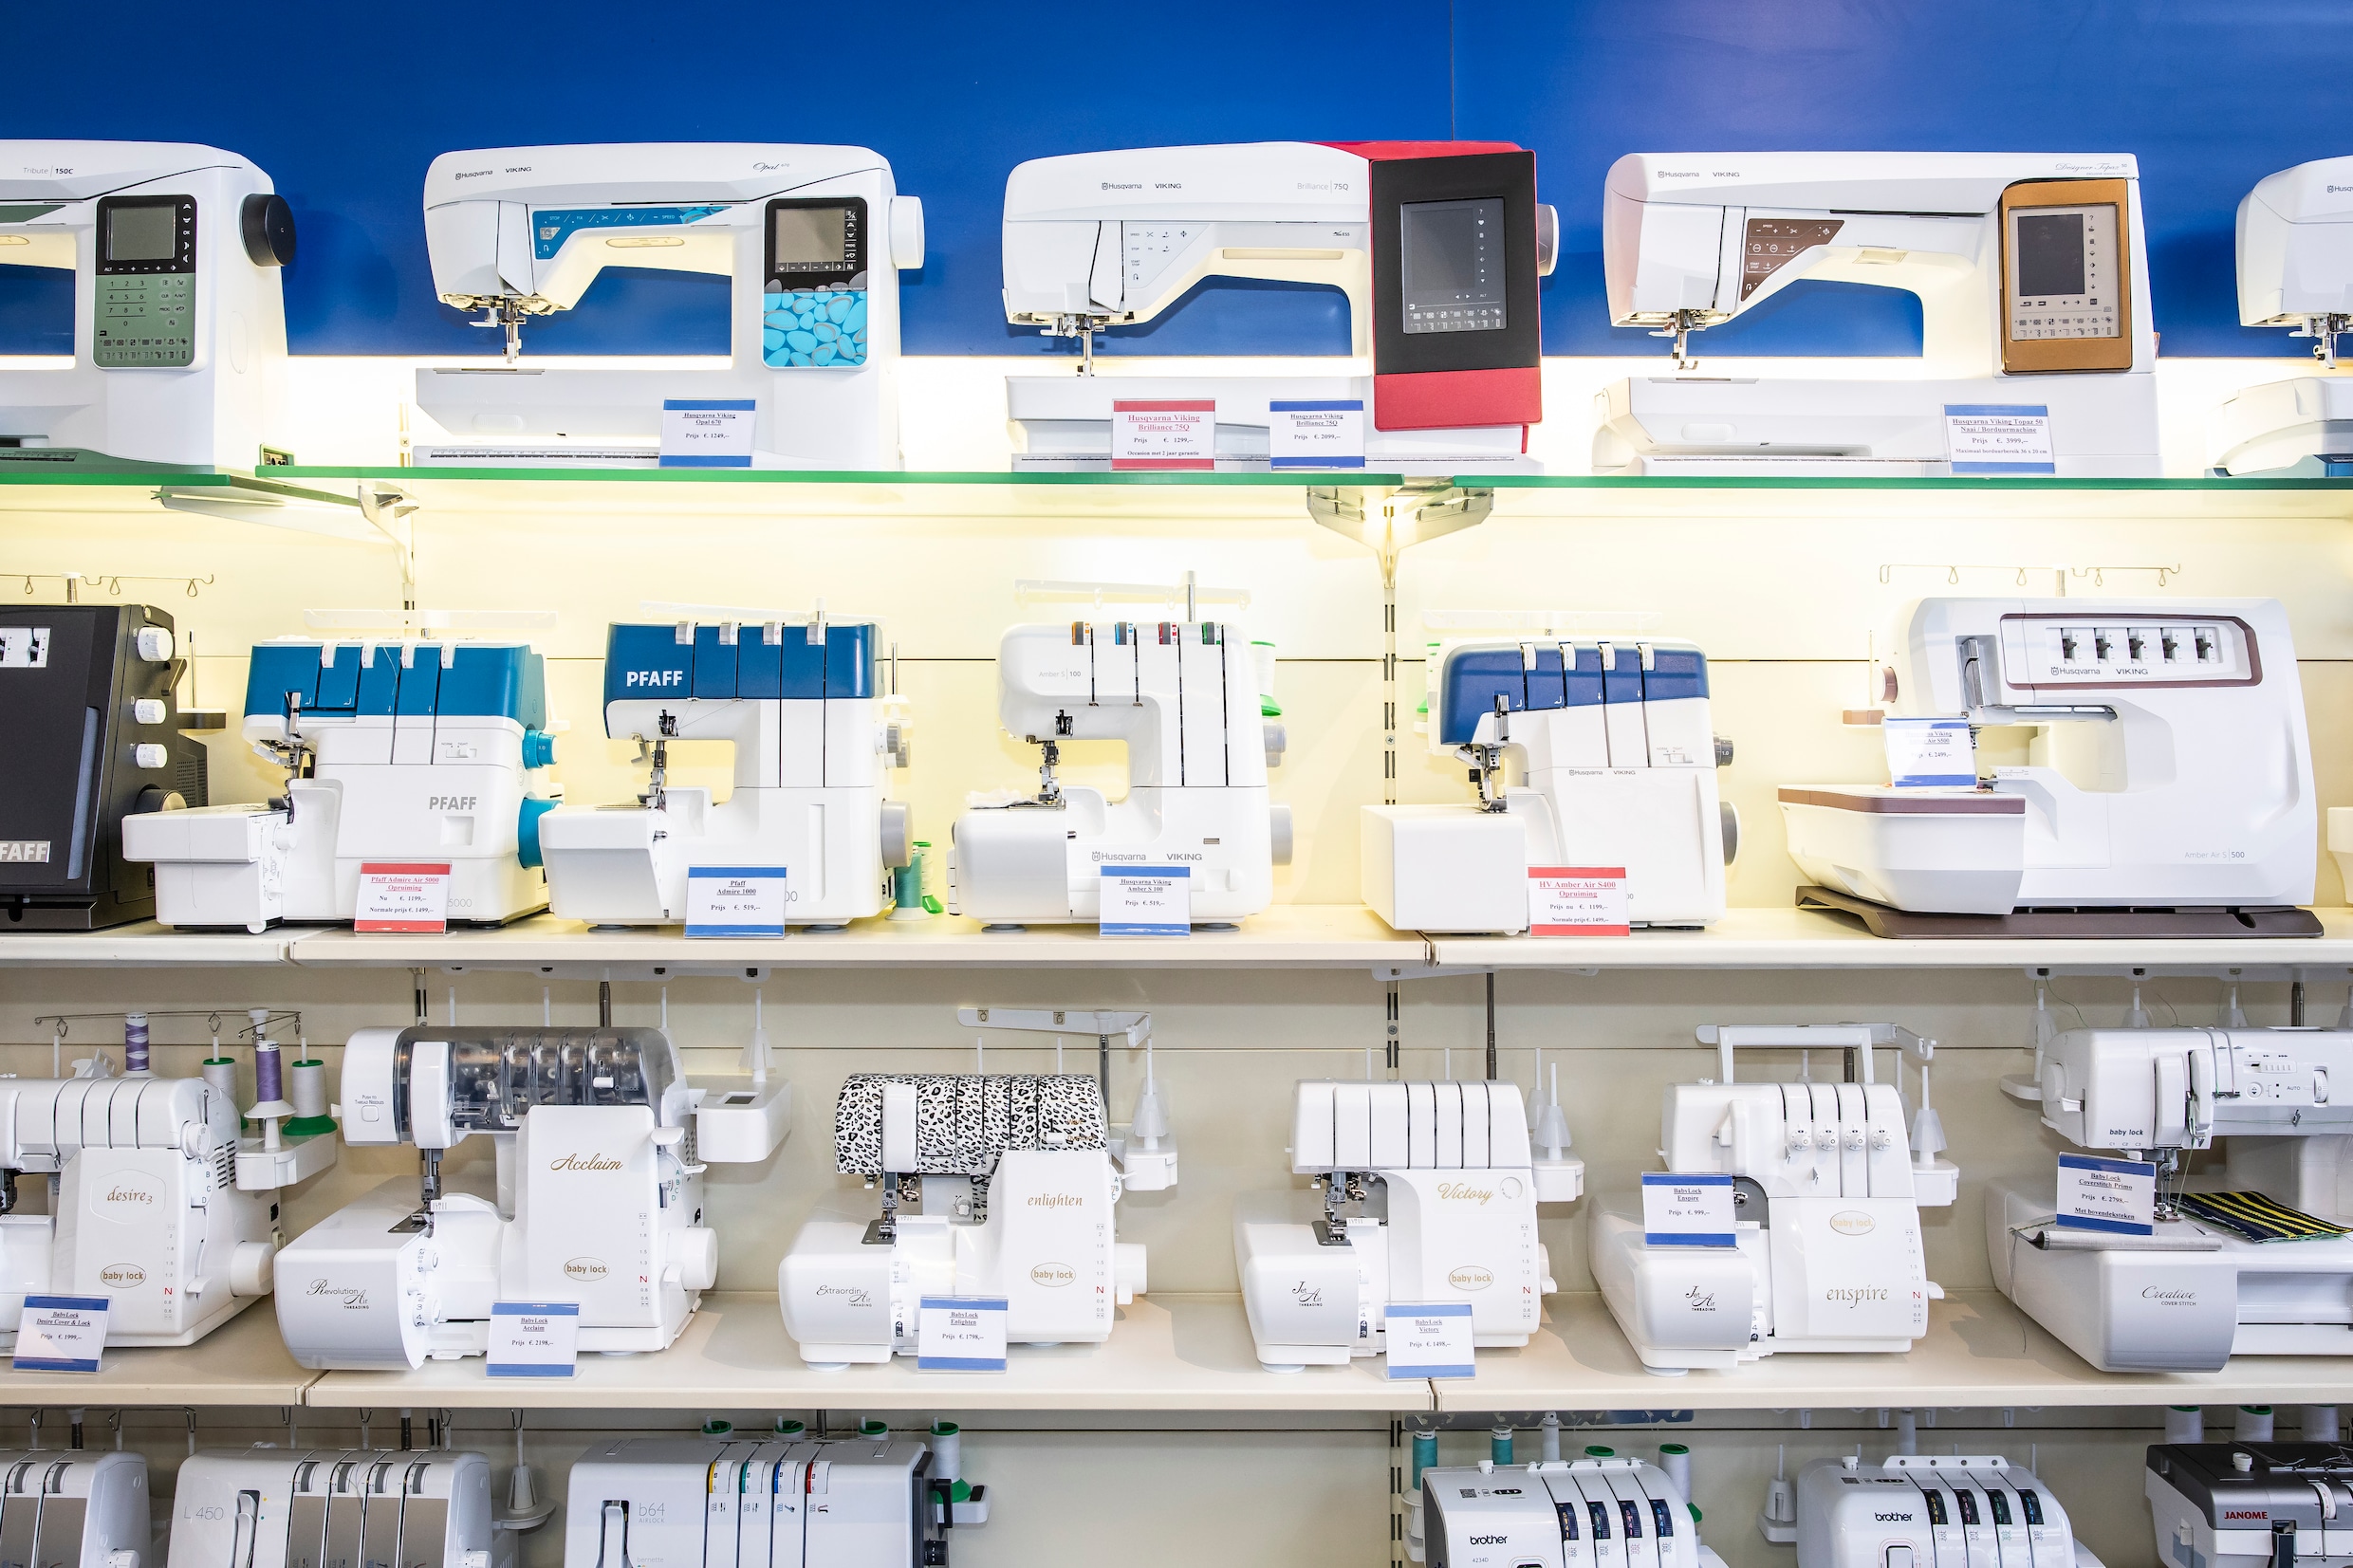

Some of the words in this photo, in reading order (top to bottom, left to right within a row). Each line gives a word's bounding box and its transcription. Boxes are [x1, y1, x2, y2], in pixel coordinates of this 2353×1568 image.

[462, 170, 492, 178] Husqvarna
[2060, 667, 2101, 676] Husqvarna
[626, 670, 683, 687] PFAFF
[429, 797, 476, 810] PFAFF
[1102, 852, 1146, 862] Husqvarna
[1166, 853, 1203, 861] VIKING
[550, 1153, 622, 1171] Acclaim
[1437, 1182, 1493, 1206] Victory
[1028, 1194, 1084, 1208] enlighten
[2088, 1209, 2135, 1219] bovendeksteken
[1833, 1218, 1853, 1227] baby
[567, 1264, 586, 1274] baby
[102, 1270, 123, 1281] baby
[126, 1271, 143, 1280] lock
[1033, 1270, 1053, 1281] baby
[1056, 1270, 1073, 1280] lock
[1452, 1274, 1471, 1284] baby
[1473, 1274, 1491, 1282] lock
[306, 1279, 358, 1295] Revolution
[2142, 1285, 2196, 1300] Creative
[343, 1289, 368, 1304] Air
[849, 1291, 871, 1303] Air
[1299, 1288, 1323, 1303] Air
[1826, 1286, 1888, 1308] enspire
[196, 1506, 224, 1520] 450
[639, 1503, 665, 1516] b64
[1875, 1512, 1913, 1522] brother
[1470, 1536, 1508, 1545] brother
